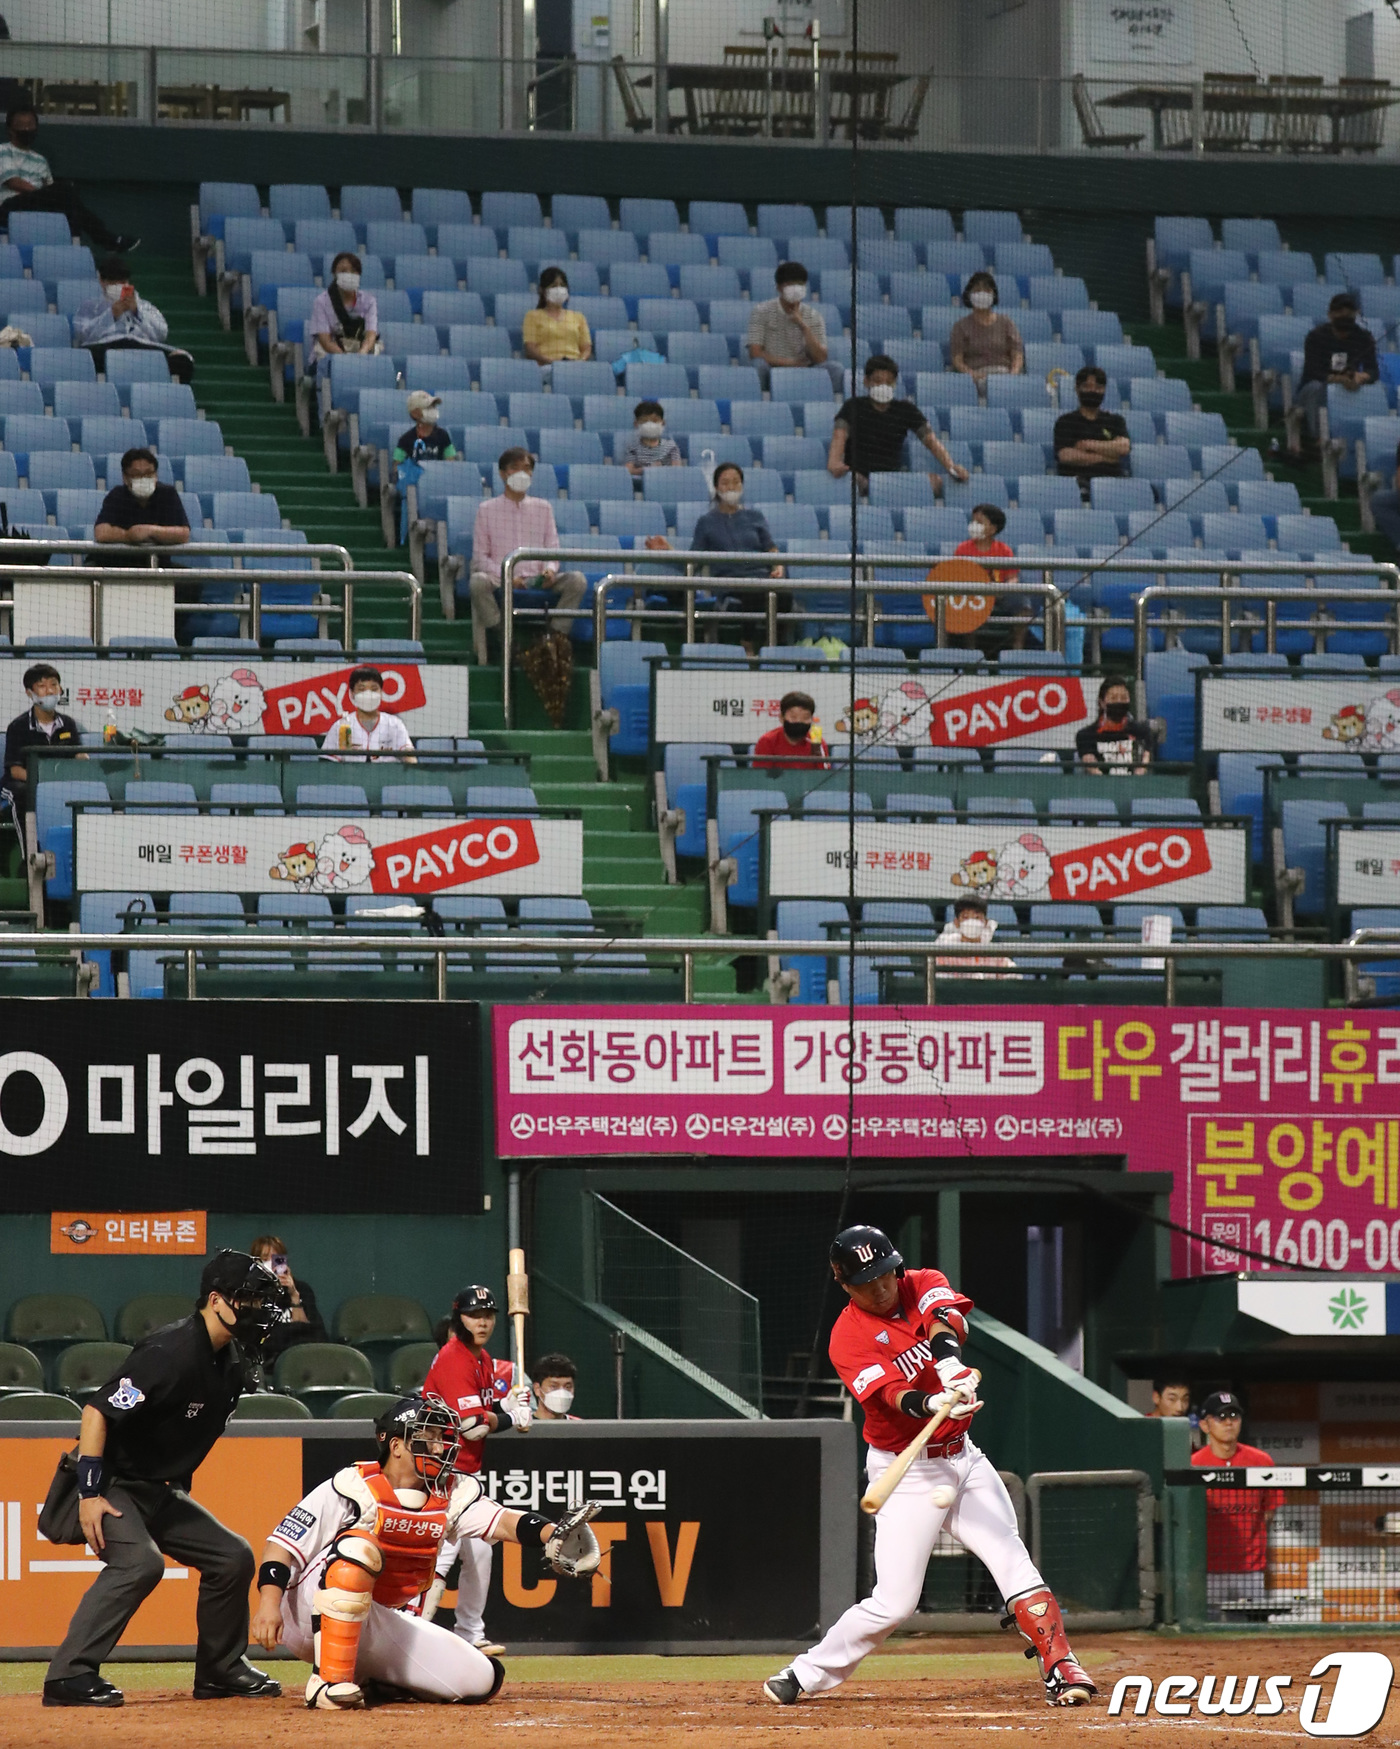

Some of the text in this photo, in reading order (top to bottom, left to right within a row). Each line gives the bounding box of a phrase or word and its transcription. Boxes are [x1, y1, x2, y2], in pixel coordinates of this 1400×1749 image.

[76, 688, 144, 707] 쿠폰생활
[277, 670, 406, 731] PAYO
[713, 699, 745, 717] 매일
[944, 682, 1068, 742] PAYCO
[1224, 706, 1251, 723] 매일
[138, 844, 248, 865] 매일 쿠폰생활
[387, 825, 519, 889] PAYCO
[826, 851, 933, 872] 매일 쿠폰생활
[1063, 834, 1192, 897] PAYCO
[1355, 859, 1384, 876] 매일
[518, 1030, 766, 1083] 선화동아파트
[794, 1031, 1036, 1083] 가양동아파트
[87, 1054, 430, 1156] 마일리지
[537, 1115, 678, 1137] 다우주택건설(주)
[712, 1116, 815, 1138] 다우건설(주)
[851, 1117, 987, 1139] 다우주택건설(주)
[1021, 1118, 1123, 1139] 다우건설(주)
[1197, 1120, 1400, 1212] 분양예
[105, 1219, 198, 1243] 인터뷰존
[383, 1518, 444, 1539] 한화생명
[438, 1521, 700, 1608] CTV
